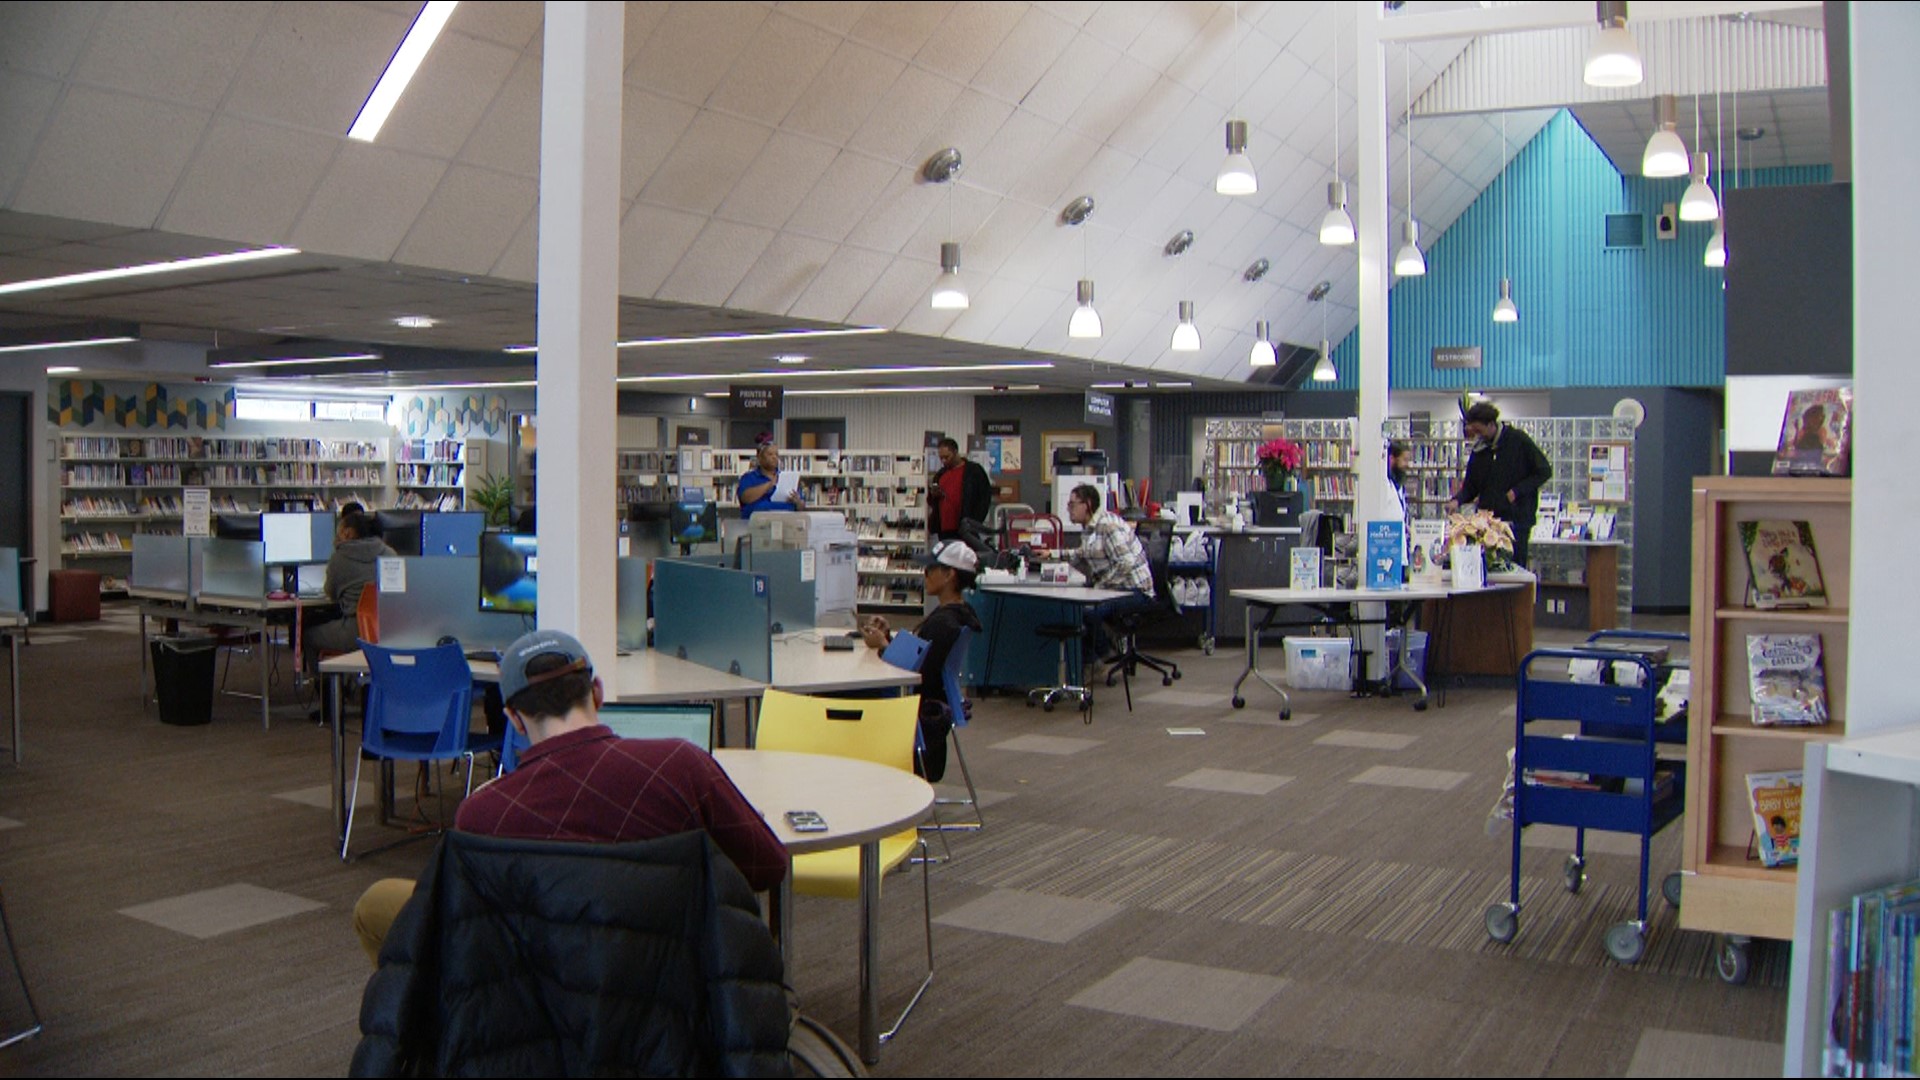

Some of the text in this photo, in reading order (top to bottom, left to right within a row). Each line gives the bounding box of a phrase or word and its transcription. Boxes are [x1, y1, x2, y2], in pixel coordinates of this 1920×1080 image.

[739, 390, 767, 398] PRINTER
[744, 400, 767, 408] COPIER
[987, 424, 1014, 432] RETURNS
